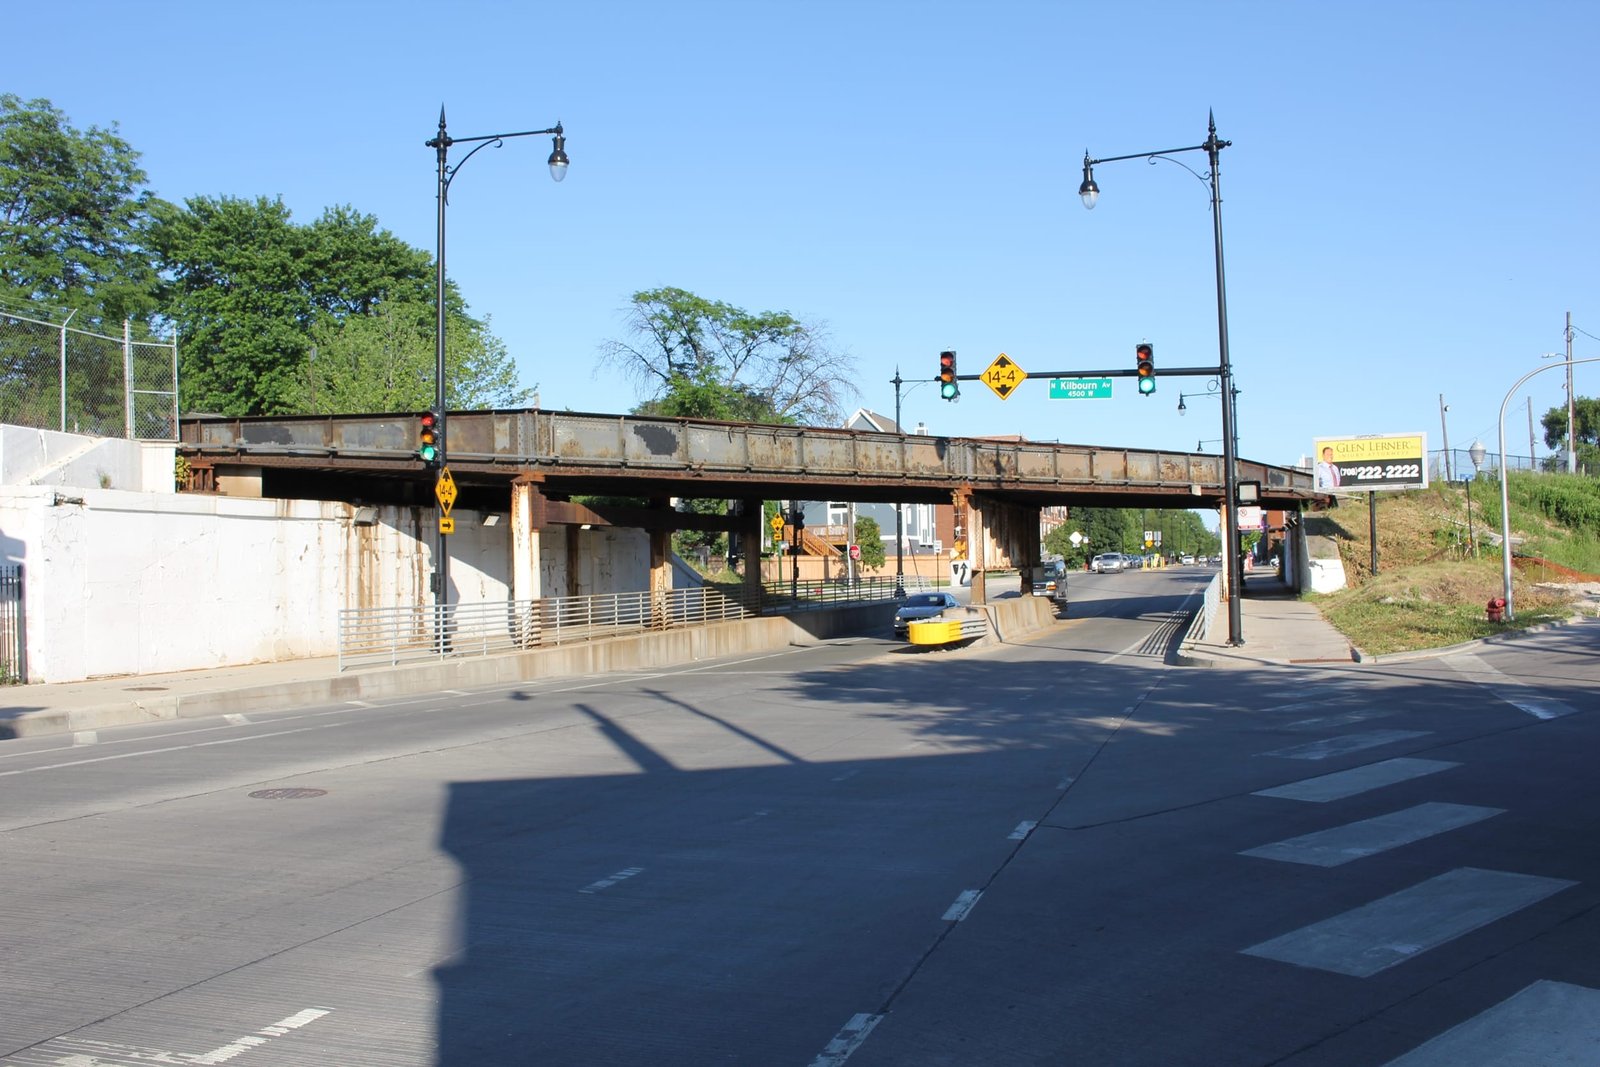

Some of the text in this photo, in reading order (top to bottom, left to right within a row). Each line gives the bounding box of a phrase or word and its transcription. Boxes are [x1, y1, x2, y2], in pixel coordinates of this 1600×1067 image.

[1060, 381, 1097, 390] Kilbourn
[1336, 440, 1409, 453] GLEN LERNER
